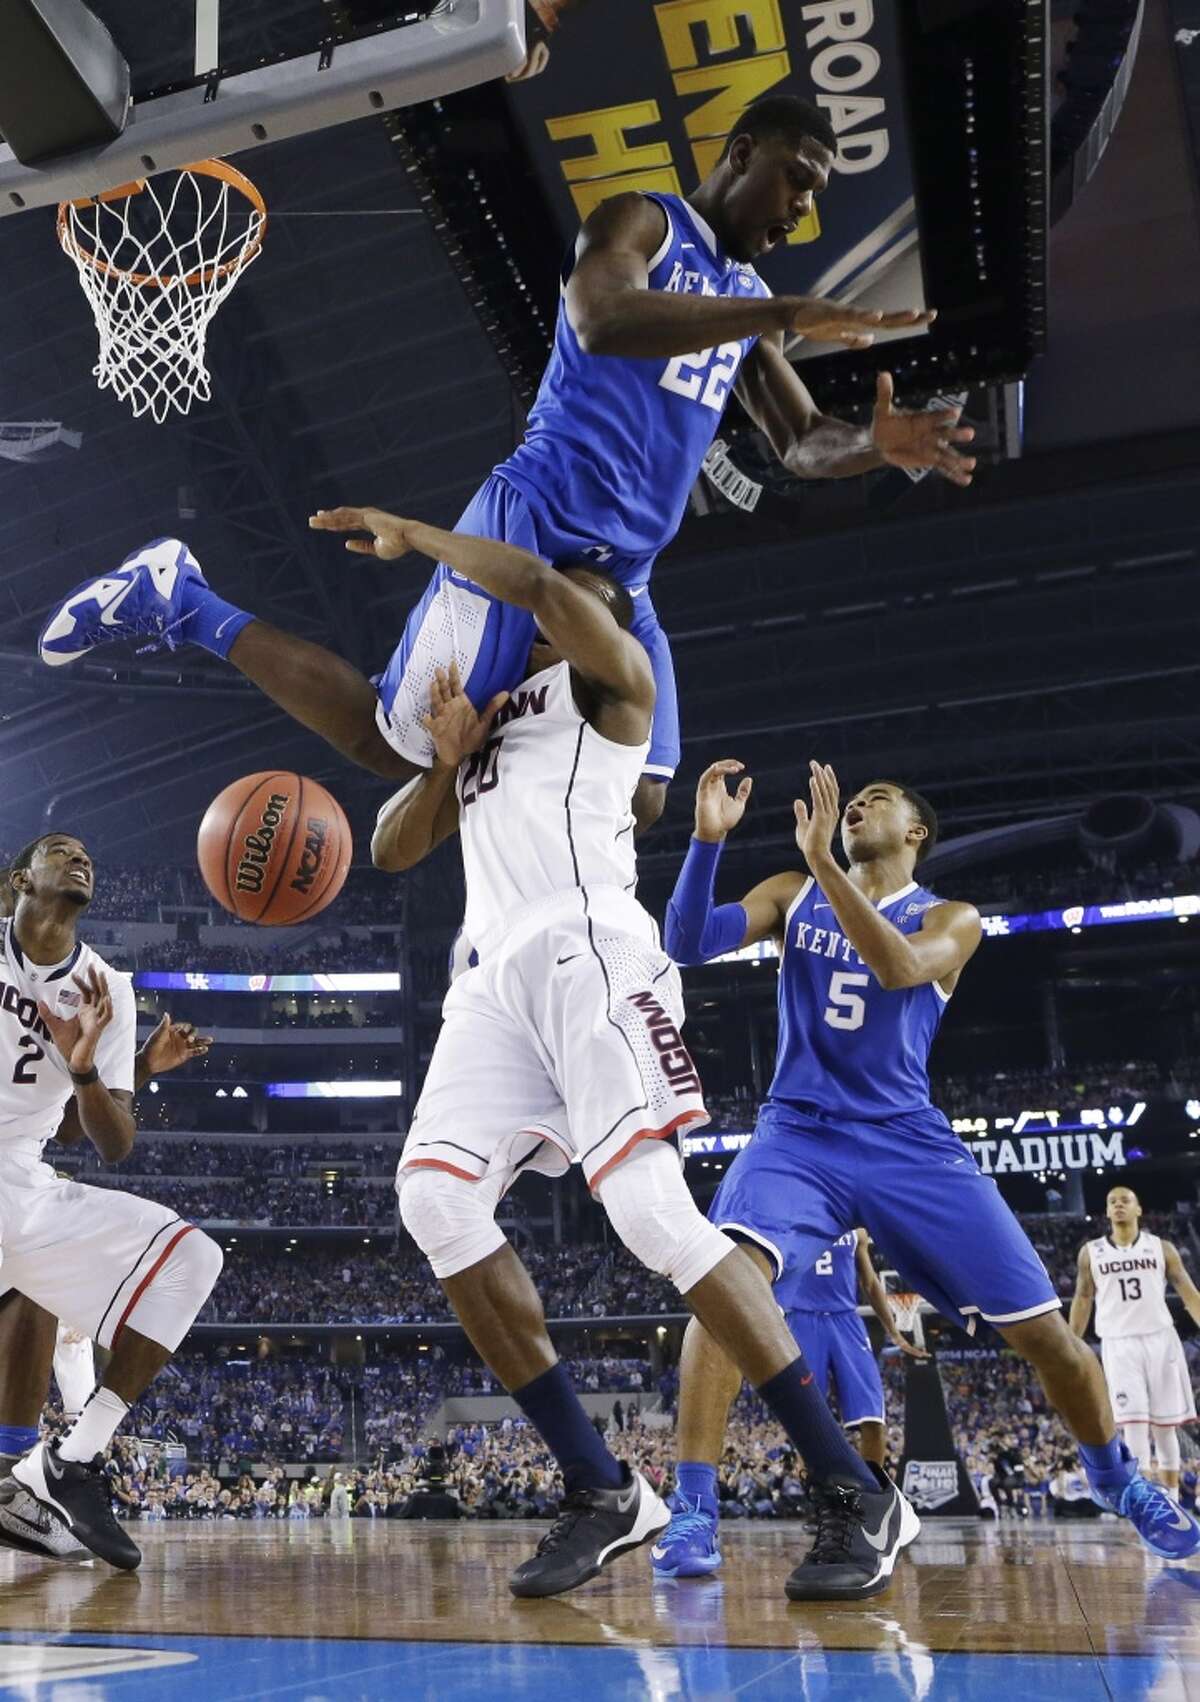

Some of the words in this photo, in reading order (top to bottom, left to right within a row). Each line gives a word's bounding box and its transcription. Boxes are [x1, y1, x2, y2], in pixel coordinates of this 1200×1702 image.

[801, 0, 890, 175] ROAD
[664, 261, 732, 297] KEN
[658, 341, 742, 413] 22
[236, 794, 290, 893] Wilson
[290, 817, 328, 895] NCAA
[795, 922, 865, 965] KENT
[0, 981, 54, 1044] CON
[824, 971, 870, 1031] 5
[12, 1035, 45, 1084] 2
[626, 991, 702, 1096] UCONN
[963, 1132, 1127, 1174] TADIUM
[815, 1250, 833, 1275] 2
[1099, 1259, 1157, 1275] UCONN
[1118, 1277, 1142, 1302] 13
